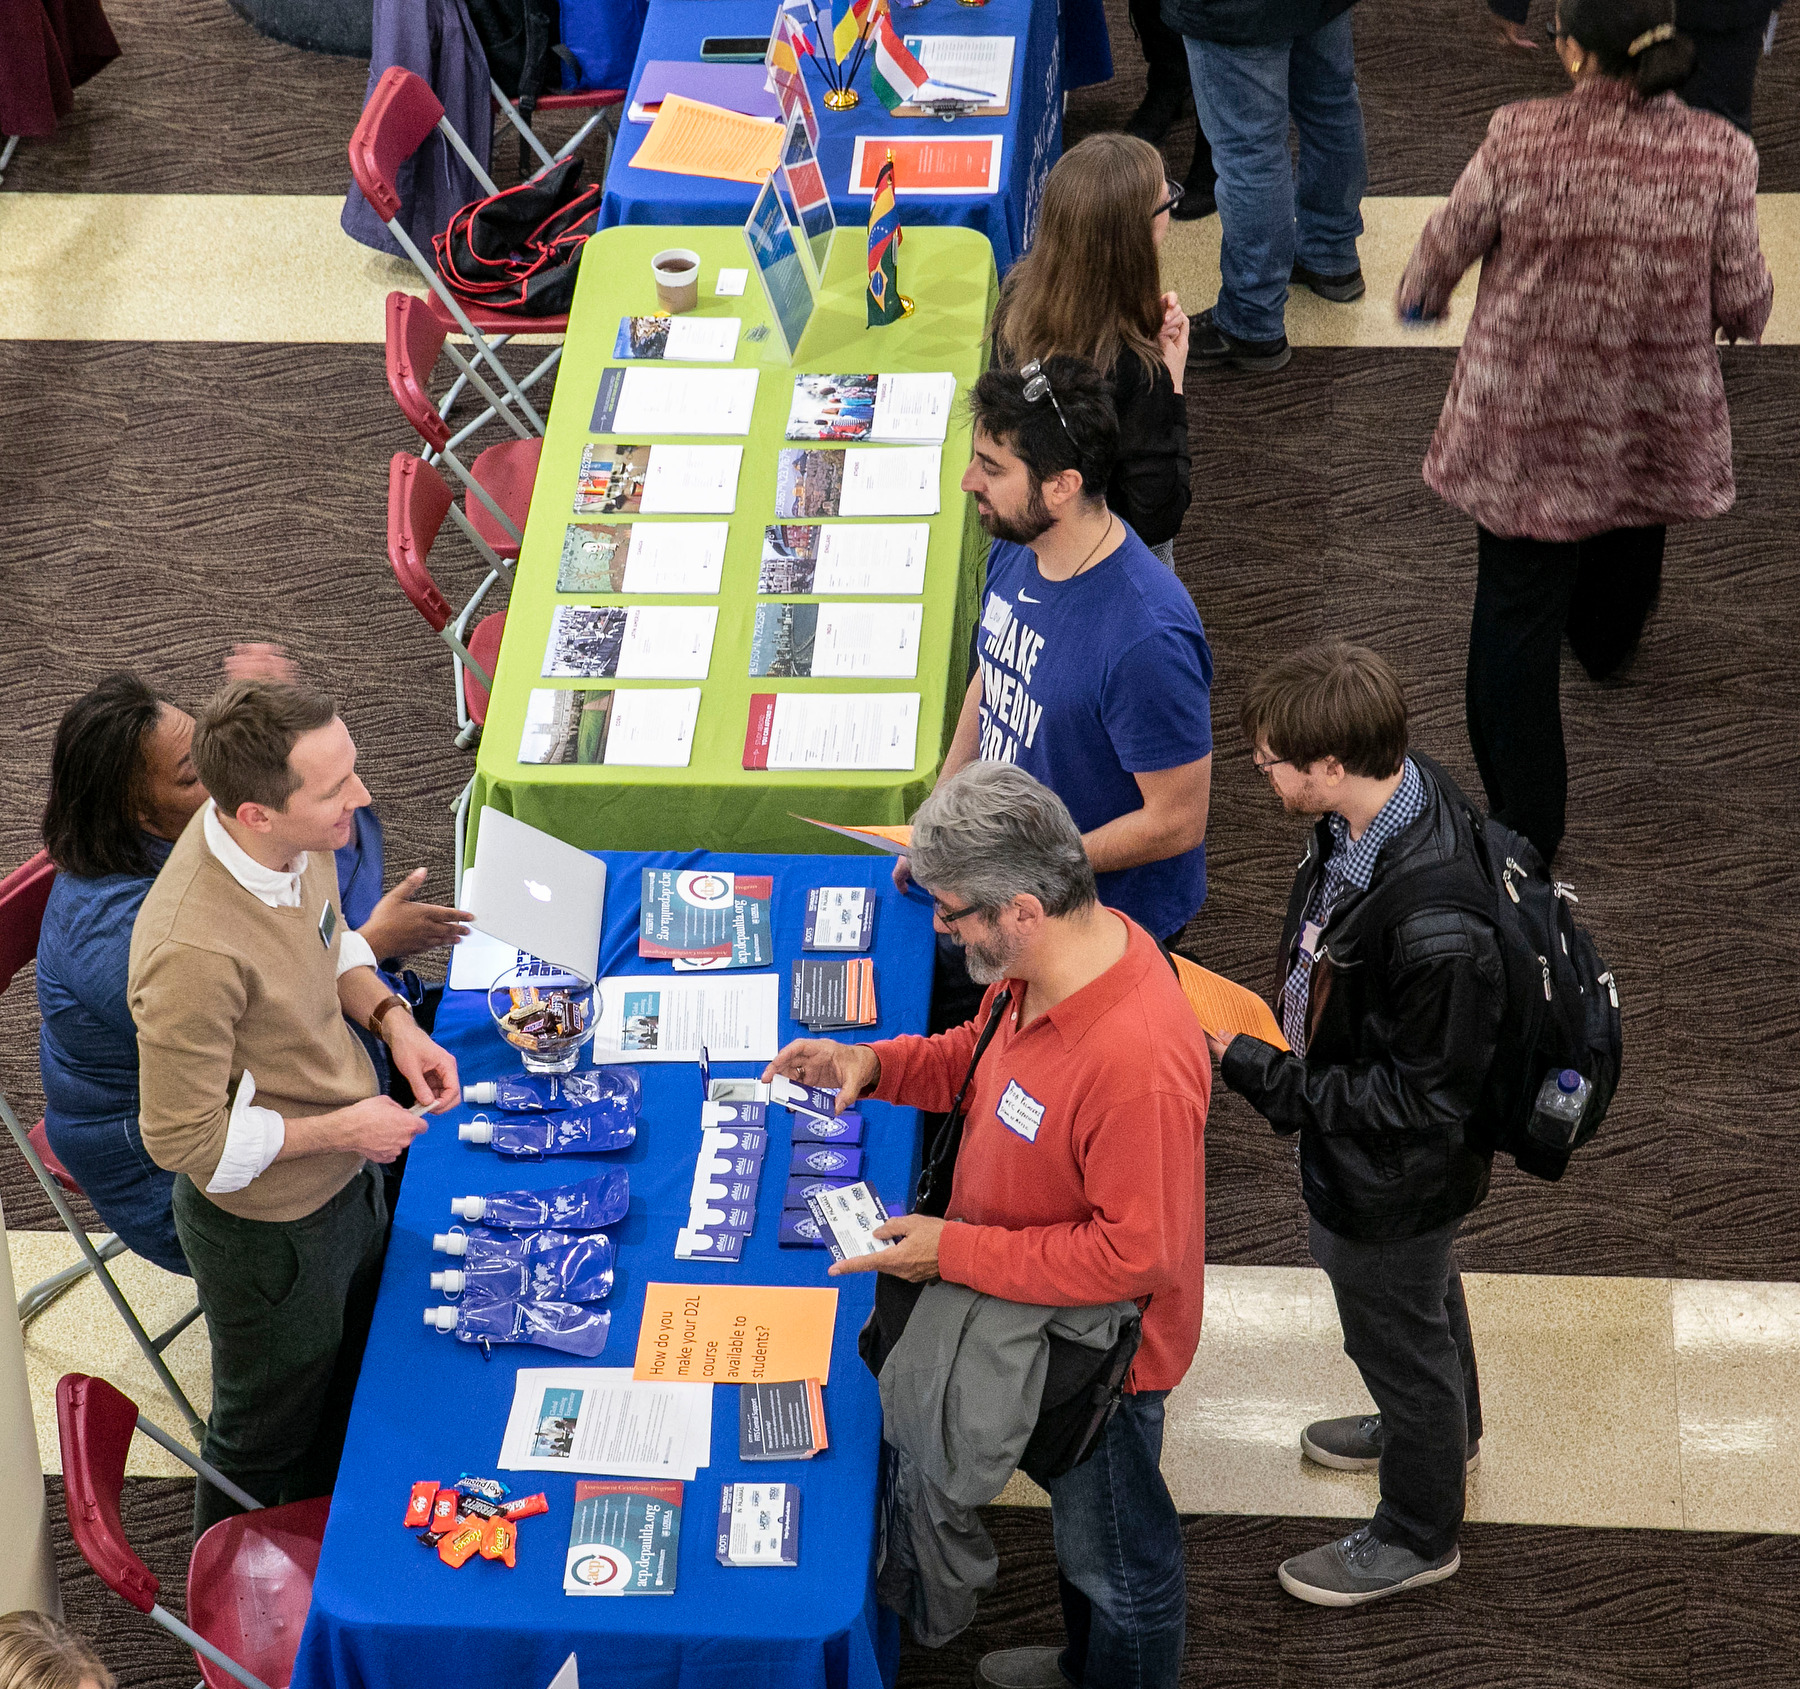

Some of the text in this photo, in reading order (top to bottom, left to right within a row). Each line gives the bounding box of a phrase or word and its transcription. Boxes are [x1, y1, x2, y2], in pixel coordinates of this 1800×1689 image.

[984, 612, 1044, 685] MAKE
[650, 1311, 674, 1375] How do you
[676, 1295, 700, 1376] make your D2L
[703, 1341, 718, 1376] course
[727, 1315, 746, 1377] available to
[753, 1325, 770, 1378] students?
[587, 1560, 604, 1581] acp
[636, 1504, 660, 1587] acp.depaultla.org
